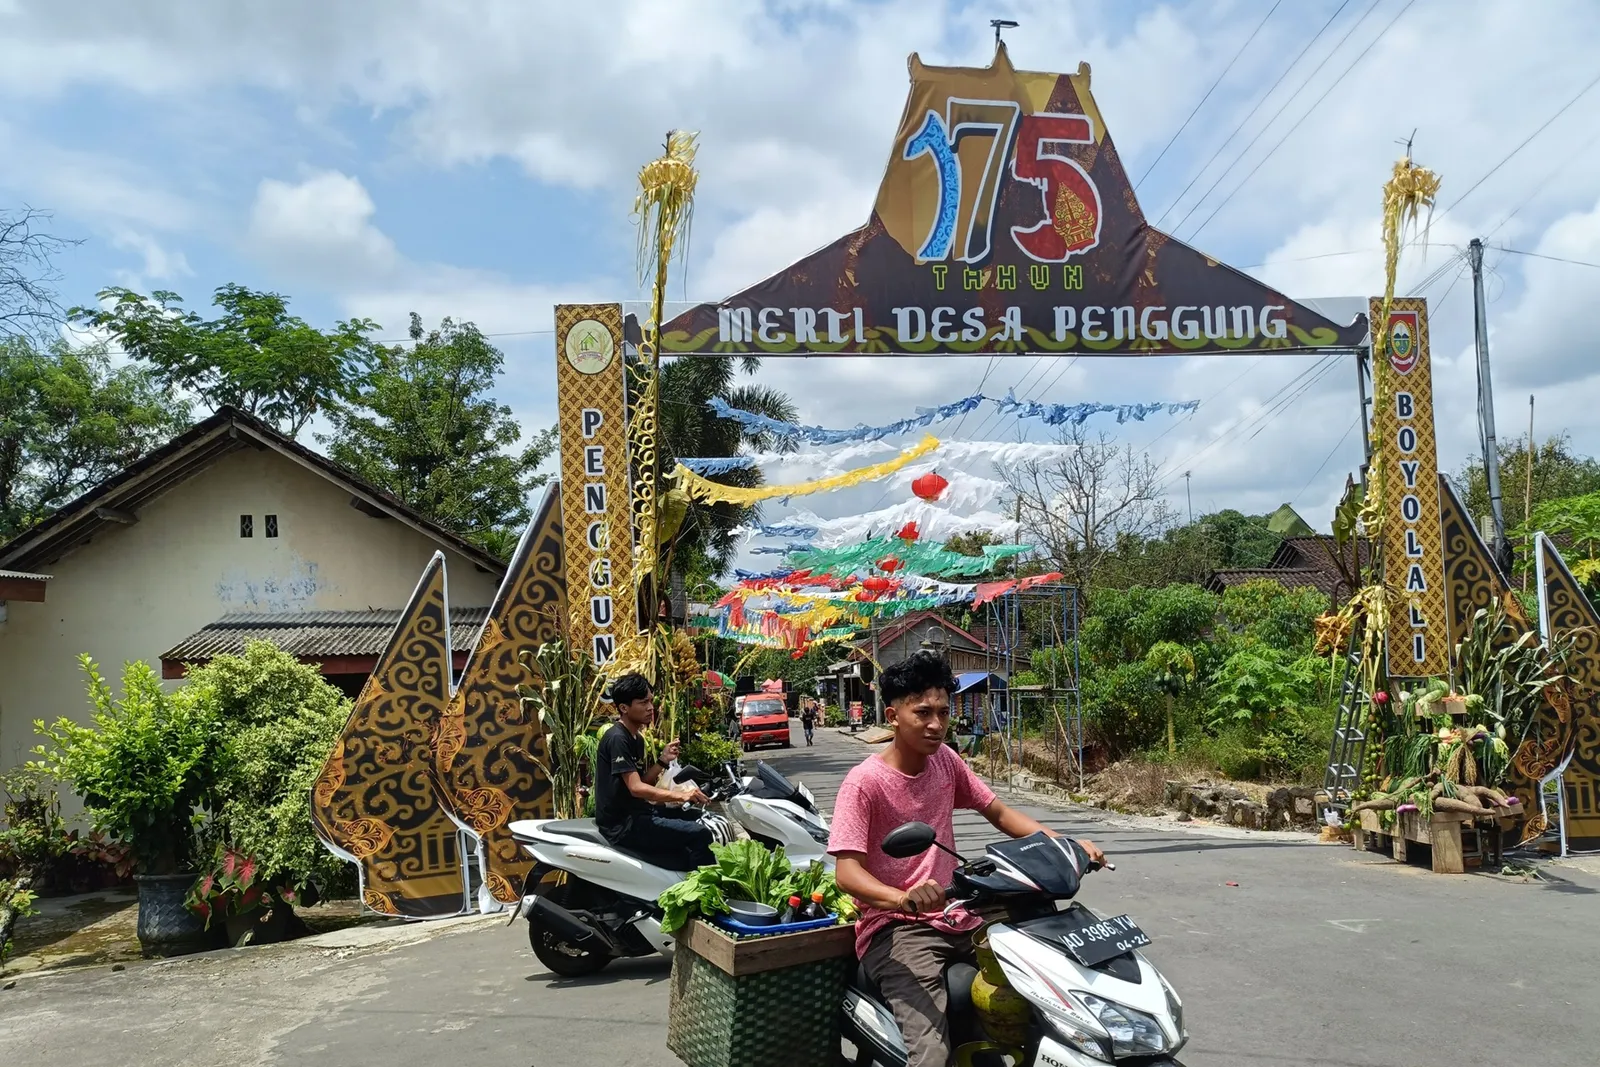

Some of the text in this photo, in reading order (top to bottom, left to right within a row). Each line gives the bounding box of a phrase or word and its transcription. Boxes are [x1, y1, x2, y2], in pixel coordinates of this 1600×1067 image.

[902, 96, 1103, 264] 175
[932, 265, 1083, 290] TAHUN
[717, 305, 1287, 343] MERTI DESA PENGGUNG
[1395, 391, 1427, 663] BOYOLALI
[1019, 841, 1046, 852] HONDA
[1062, 932, 1085, 948] AD
[1081, 920, 1117, 942] 3986
